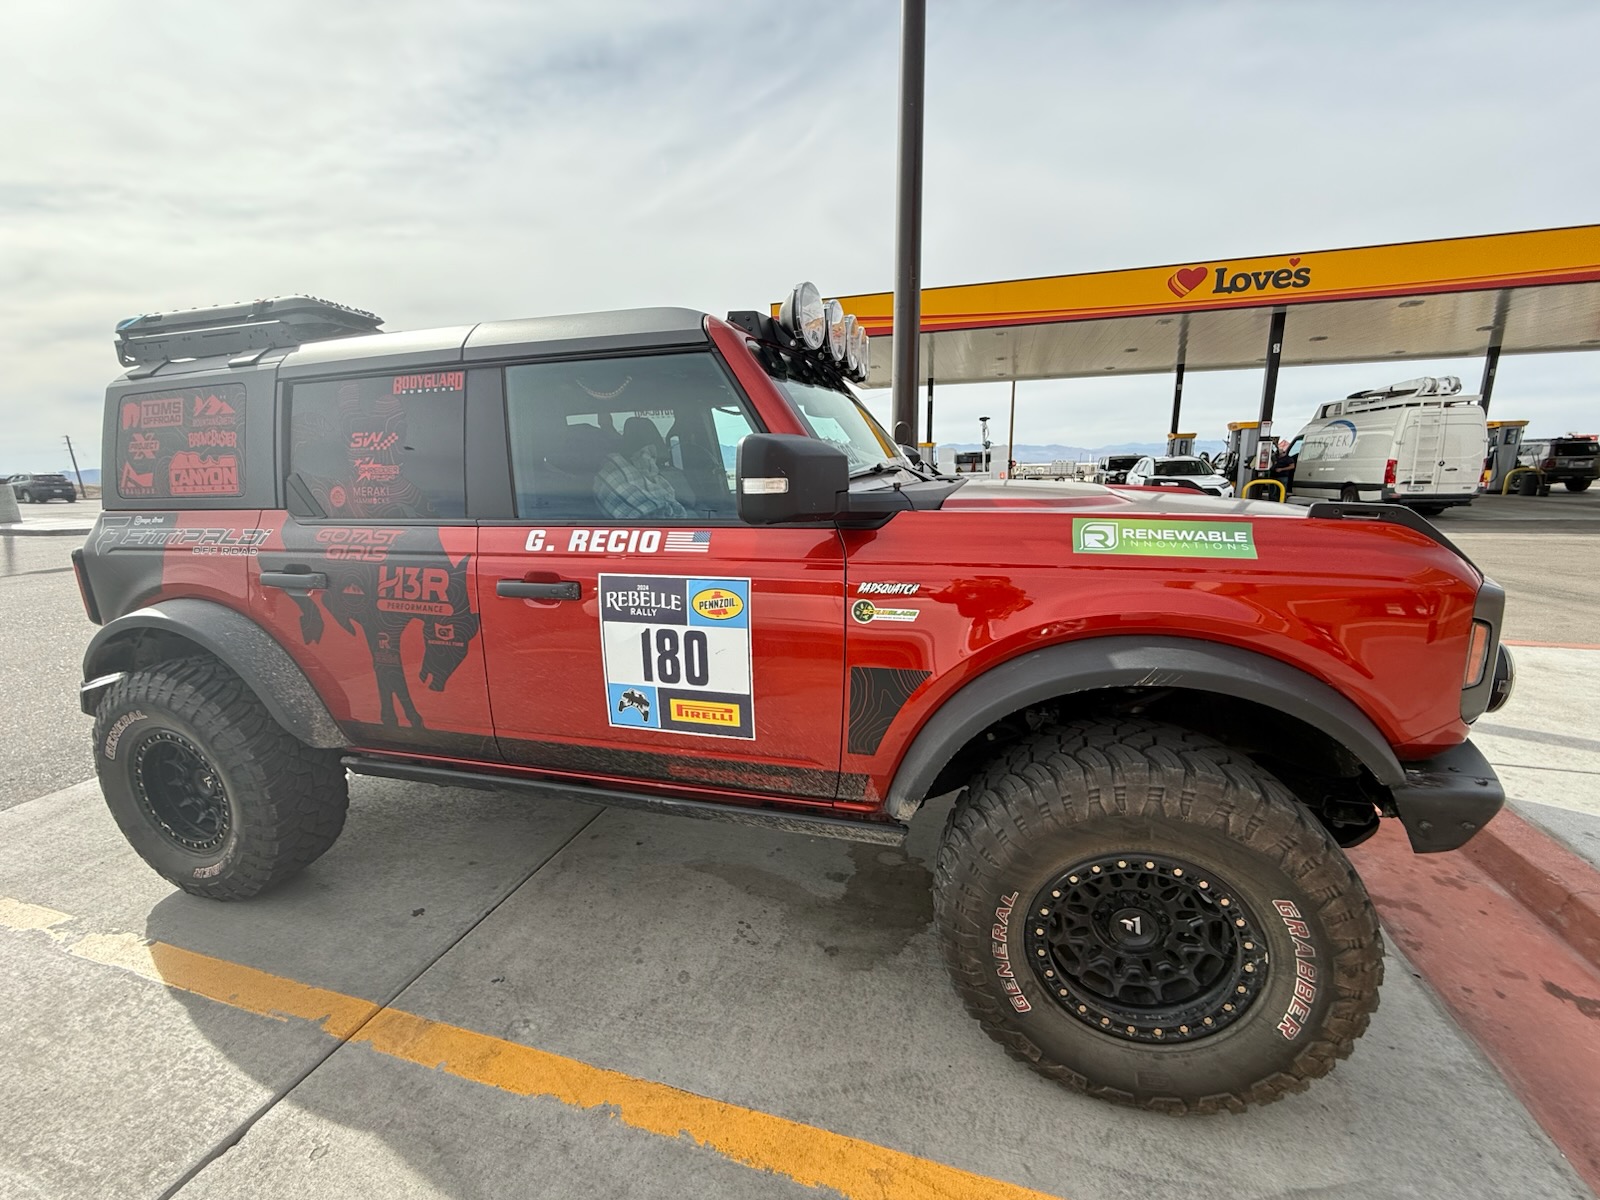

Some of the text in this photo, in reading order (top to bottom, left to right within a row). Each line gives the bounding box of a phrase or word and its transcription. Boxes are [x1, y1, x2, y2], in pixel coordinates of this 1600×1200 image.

[392, 371, 465, 395] BODYGUARD
[143, 402, 181, 415] TOMS
[143, 413, 181, 425] OFFROAD
[171, 467, 236, 486] CANYON
[353, 486, 390, 496] MERAKI
[316, 527, 405, 544] GO FAST
[524, 529, 662, 553] G. RECIO
[1122, 528, 1247, 542] RENEWABLE
[192, 546, 258, 556] OFF ROAD
[325, 544, 388, 563] GIRLS
[1122, 540, 1250, 551] INNOVATIONS
[377, 565, 449, 602] H3R
[857, 582, 920, 595] BADSQUATCH
[387, 602, 443, 613] PERFORMANCE
[605, 590, 682, 612] REBELLE
[699, 598, 738, 610] PENNZOIL
[630, 607, 658, 617] RALLY
[640, 628, 709, 687] 180
[676, 703, 734, 722] PIRELLI
[105, 710, 148, 760] GENERAL
[991, 890, 1032, 1013] GENERAL
[1272, 899, 1317, 1041] GRABBER
